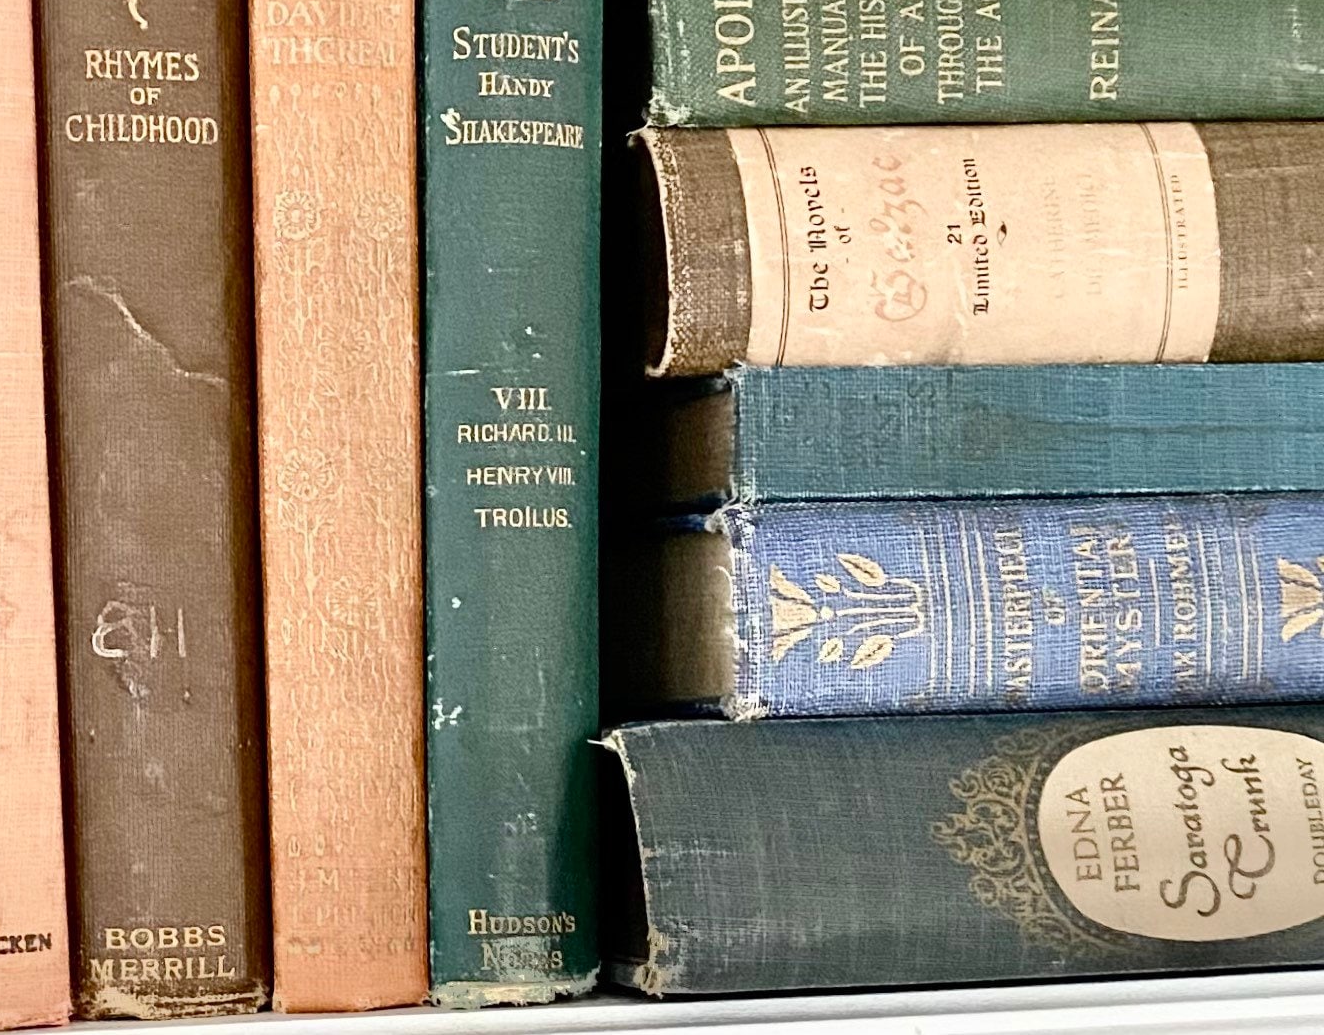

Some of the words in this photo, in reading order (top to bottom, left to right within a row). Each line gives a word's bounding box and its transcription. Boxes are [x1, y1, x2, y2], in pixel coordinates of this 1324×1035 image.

[452, 26, 580, 64] STUDENT'S
[899, 35, 926, 77] OF
[976, 35, 1005, 93] THE
[84, 49, 201, 82] RHYMES
[477, 71, 555, 98] HANDY
[859, 50, 888, 108] THE
[129, 86, 162, 106] OF
[784, 77, 811, 114] AN
[64, 113, 219, 146] CHILDHOOD
[443, 109, 585, 149] SHAKESPEARE
[799, 165, 828, 253] Novels
[962, 157, 987, 227] Edition
[838, 224, 852, 245] of
[946, 222, 963, 246] 21
[808, 262, 830, 314] The
[972, 234, 991, 317] Limited
[465, 466, 543, 486] HENRY
[473, 505, 573, 528] TROILUS.
[1065, 786, 1103, 883] EDNA
[1100, 772, 1141, 893] FERBER
[1159, 744, 1222, 918] Saratoga
[1221, 753, 1276, 900] Trunk
[104, 925, 227, 950] BOBBS
[467, 908, 577, 935] HUDSON'S
[88, 954, 236, 983] MERRILL
